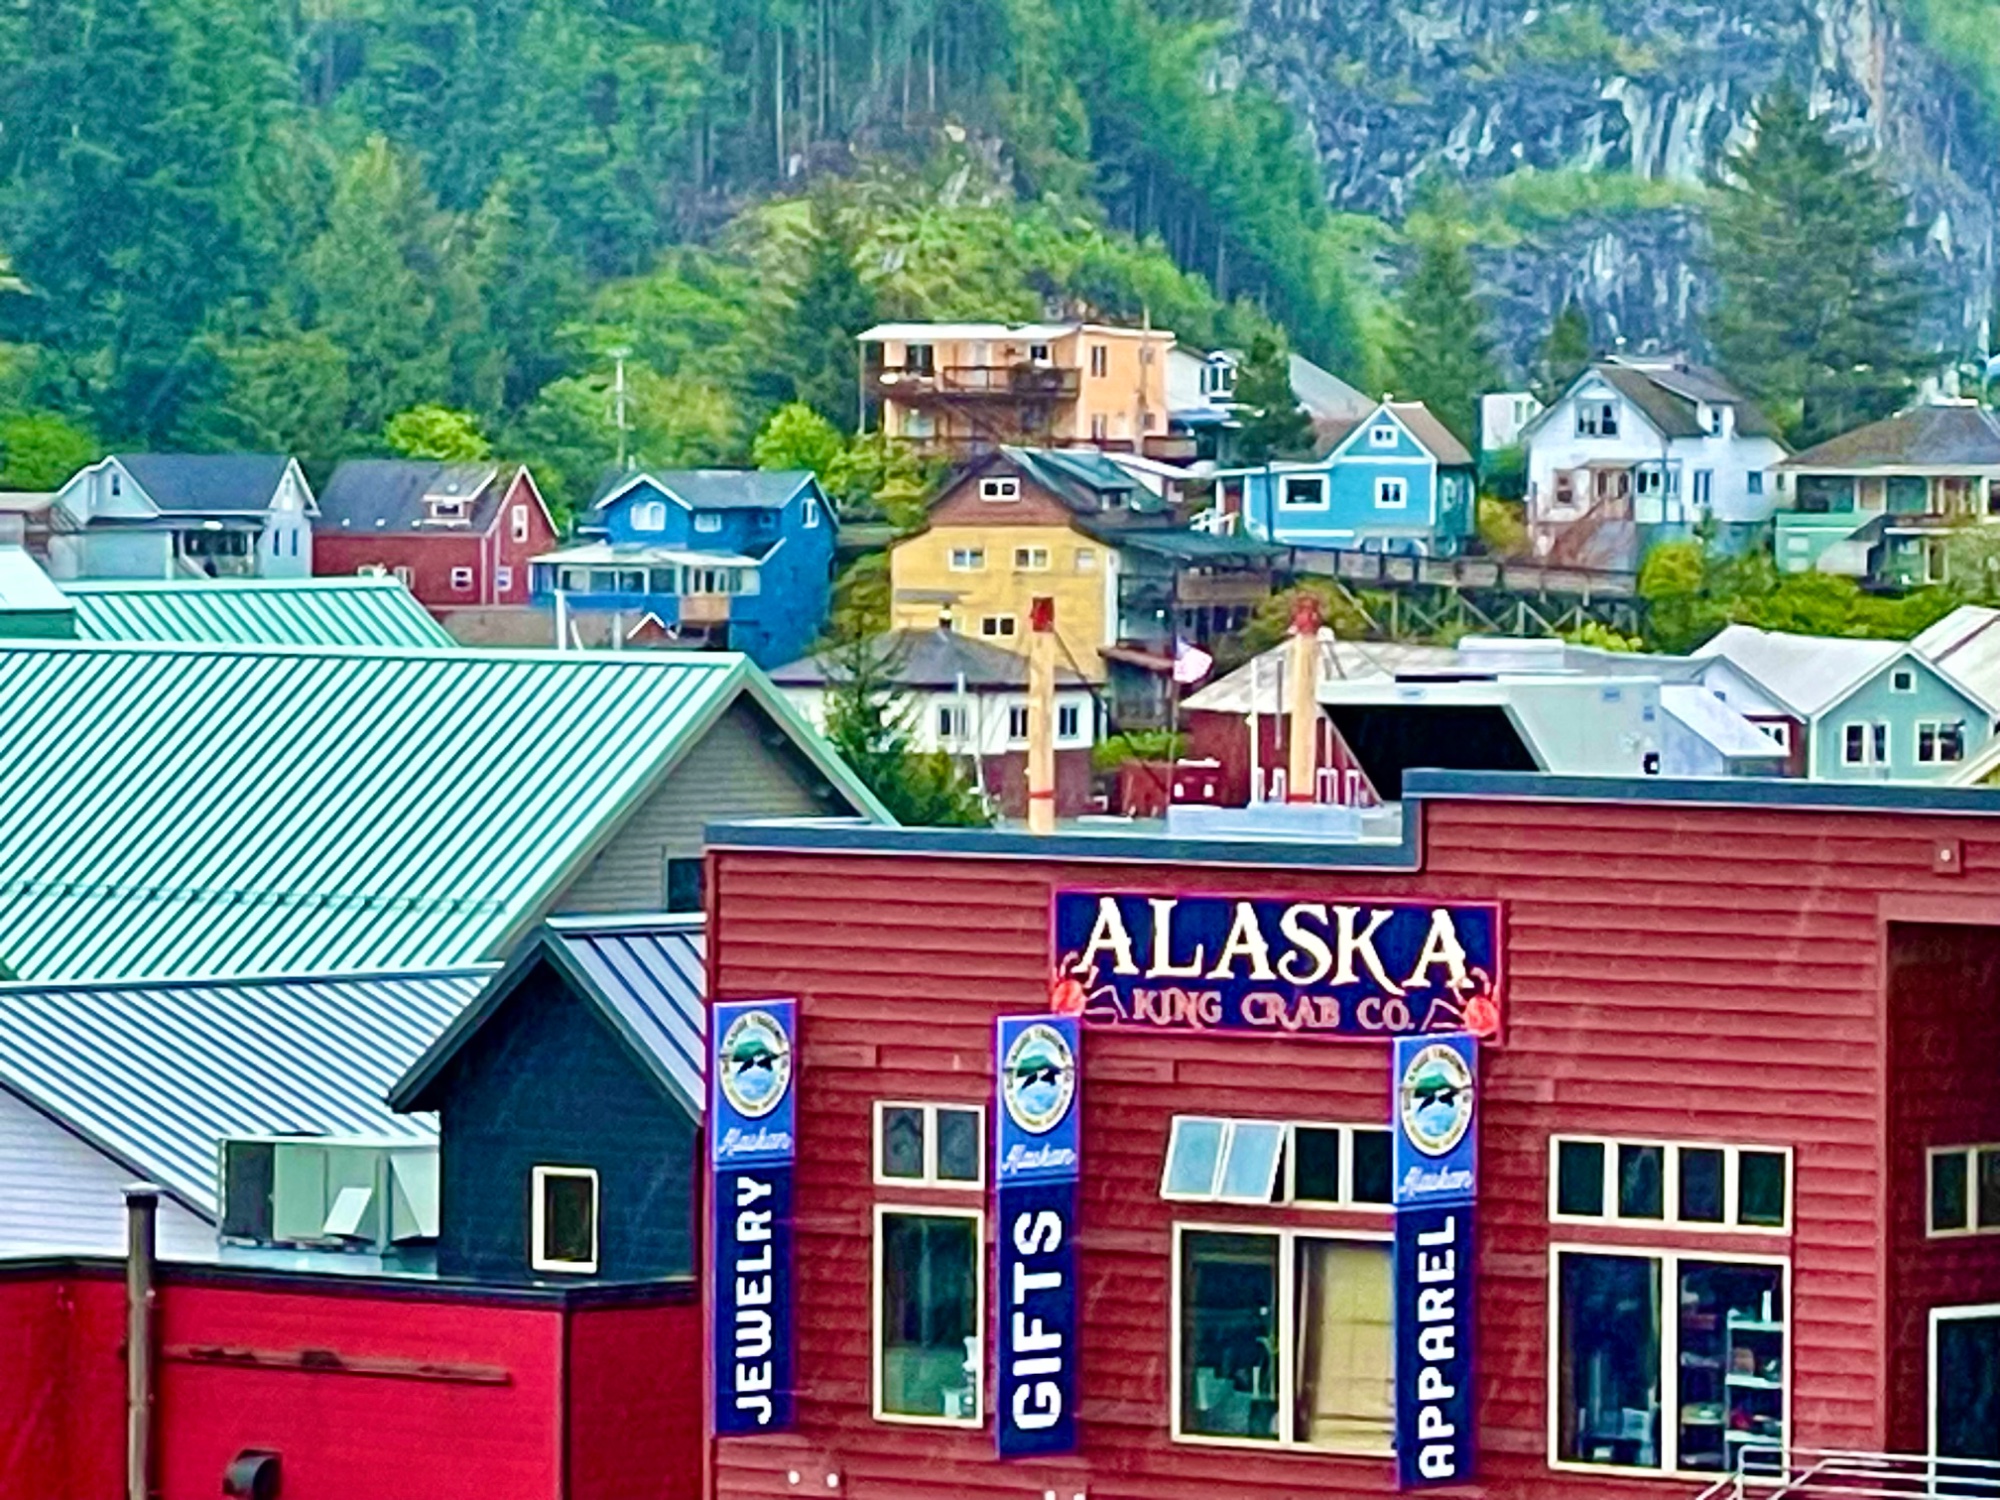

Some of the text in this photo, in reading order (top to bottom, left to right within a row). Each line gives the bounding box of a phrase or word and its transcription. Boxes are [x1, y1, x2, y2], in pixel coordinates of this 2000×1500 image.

[1071, 896, 1475, 996] ALASKA
[1131, 985, 1417, 1031] KING CRAB CO.
[735, 1176, 772, 1425] JEWELRY
[1013, 1211, 1062, 1430] GIFTS
[1417, 1215, 1455, 1479] APPAREL
